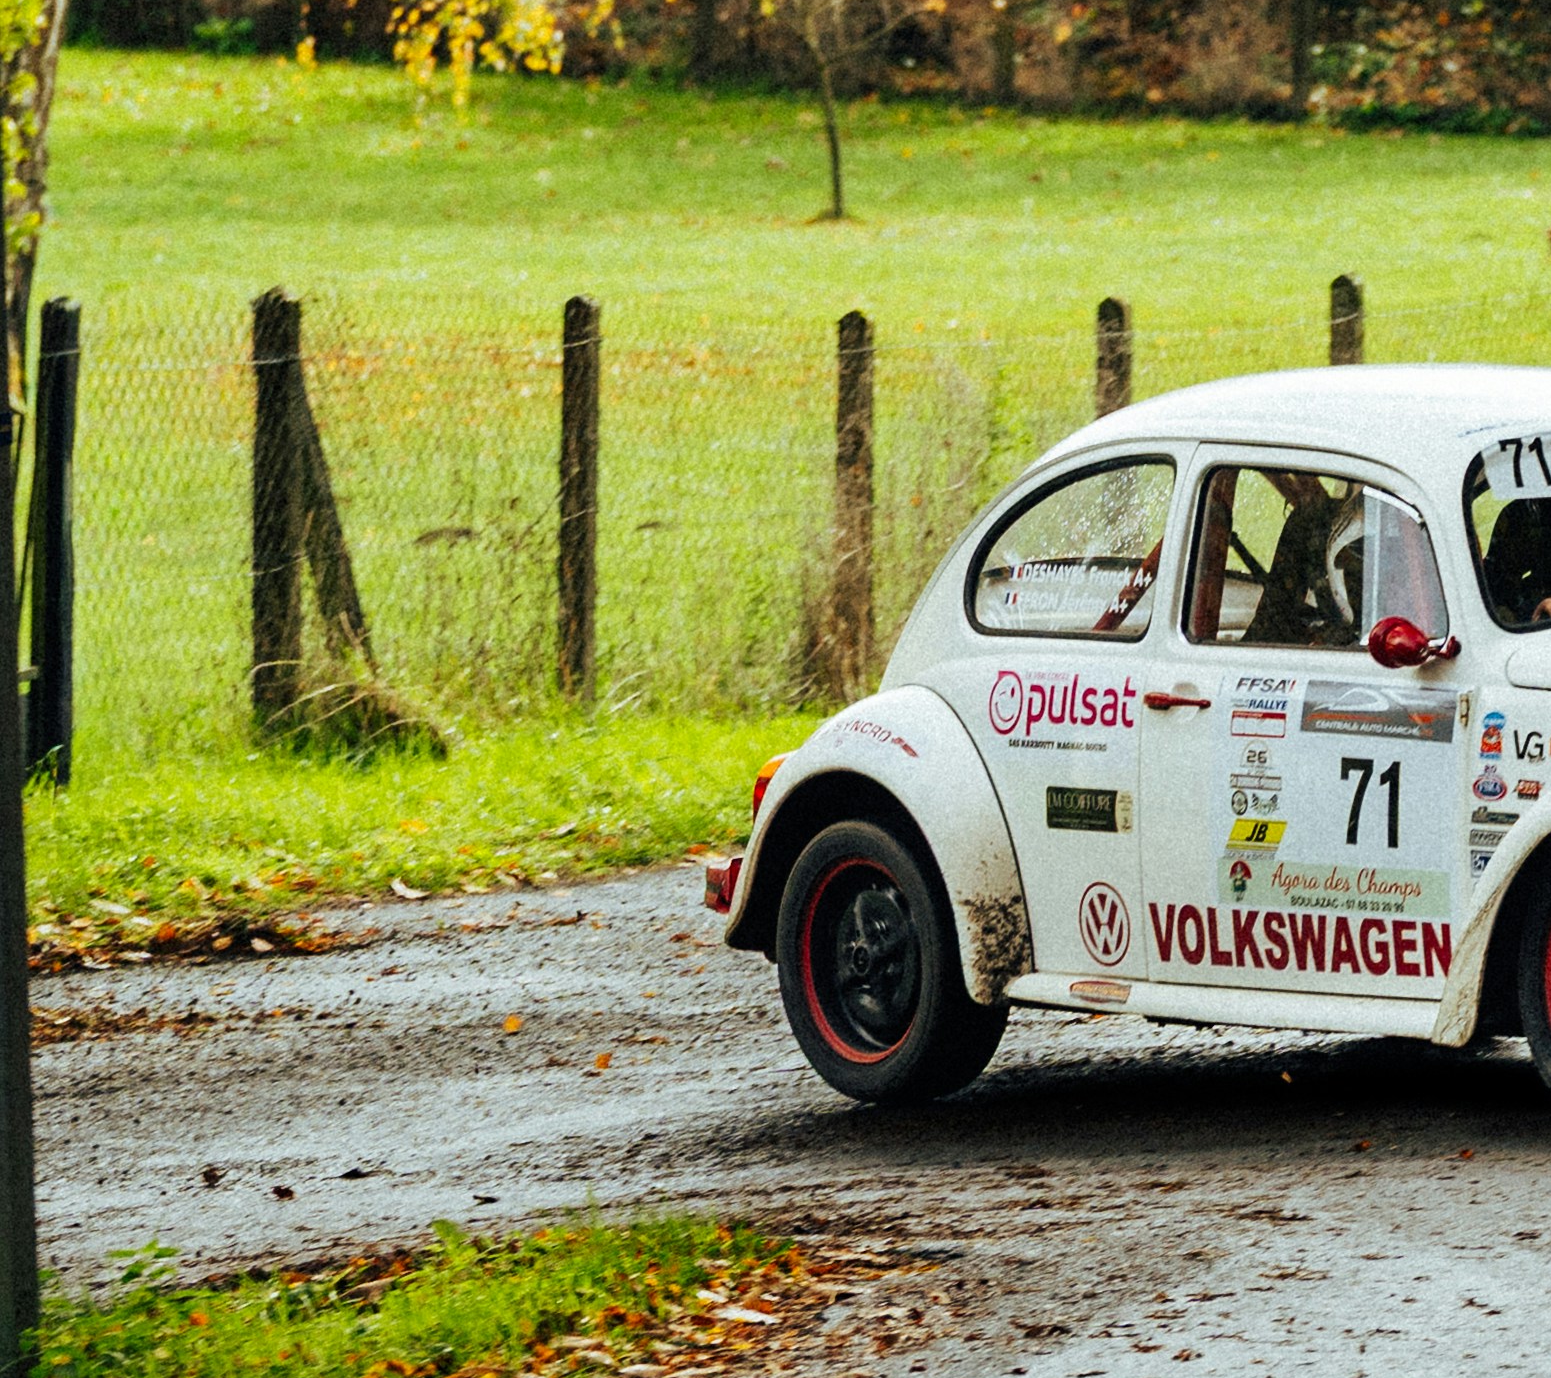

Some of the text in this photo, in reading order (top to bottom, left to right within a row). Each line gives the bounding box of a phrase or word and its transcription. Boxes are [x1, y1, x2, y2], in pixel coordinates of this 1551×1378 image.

[1133, 567, 1152, 587] A+
[1109, 595, 1129, 614] A+
[1026, 674, 1136, 736] pulsat
[1248, 699, 1288, 711] RALLYE
[834, 720, 893, 742] SYNCRO
[1513, 730, 1545, 760] VG
[1246, 749, 1268, 765] 26
[1340, 757, 1401, 849] 71
[1245, 823, 1269, 843] JB
[1271, 862, 1422, 905] Agora des Champs
[1148, 902, 1452, 979] VOLKSWAGEN
